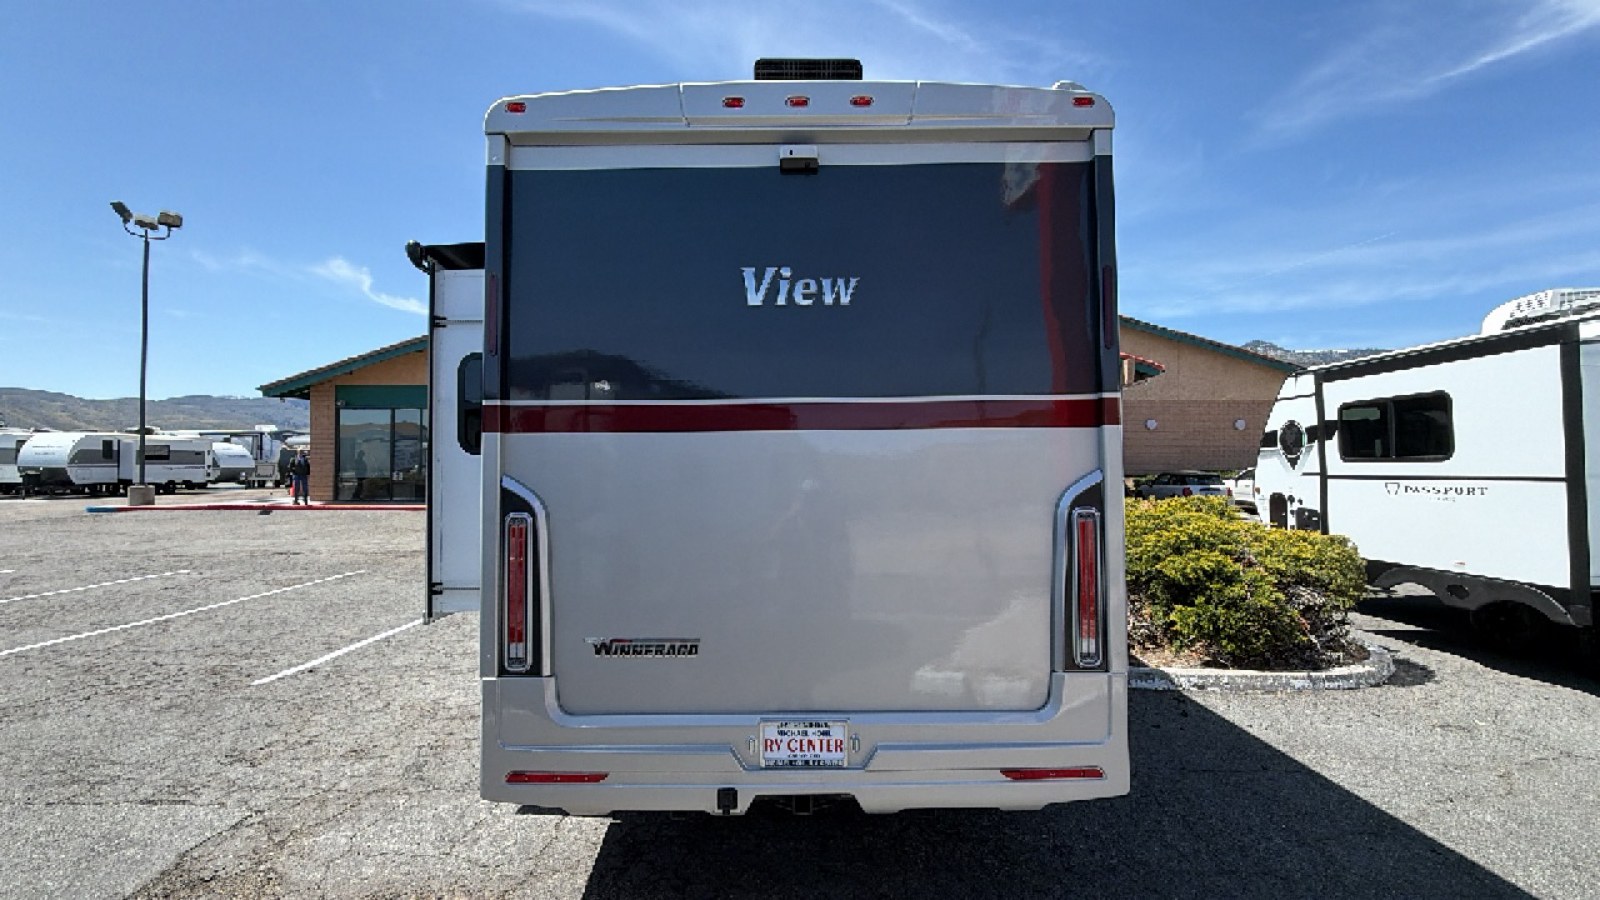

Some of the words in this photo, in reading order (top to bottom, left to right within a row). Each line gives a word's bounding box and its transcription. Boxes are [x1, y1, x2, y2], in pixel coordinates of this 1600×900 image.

[740, 266, 860, 306] View
[1404, 485, 1488, 496] PASSPORT
[593, 641, 700, 658] WINNEBAGO
[764, 738, 783, 753] RV
[786, 738, 844, 753] CENTER
